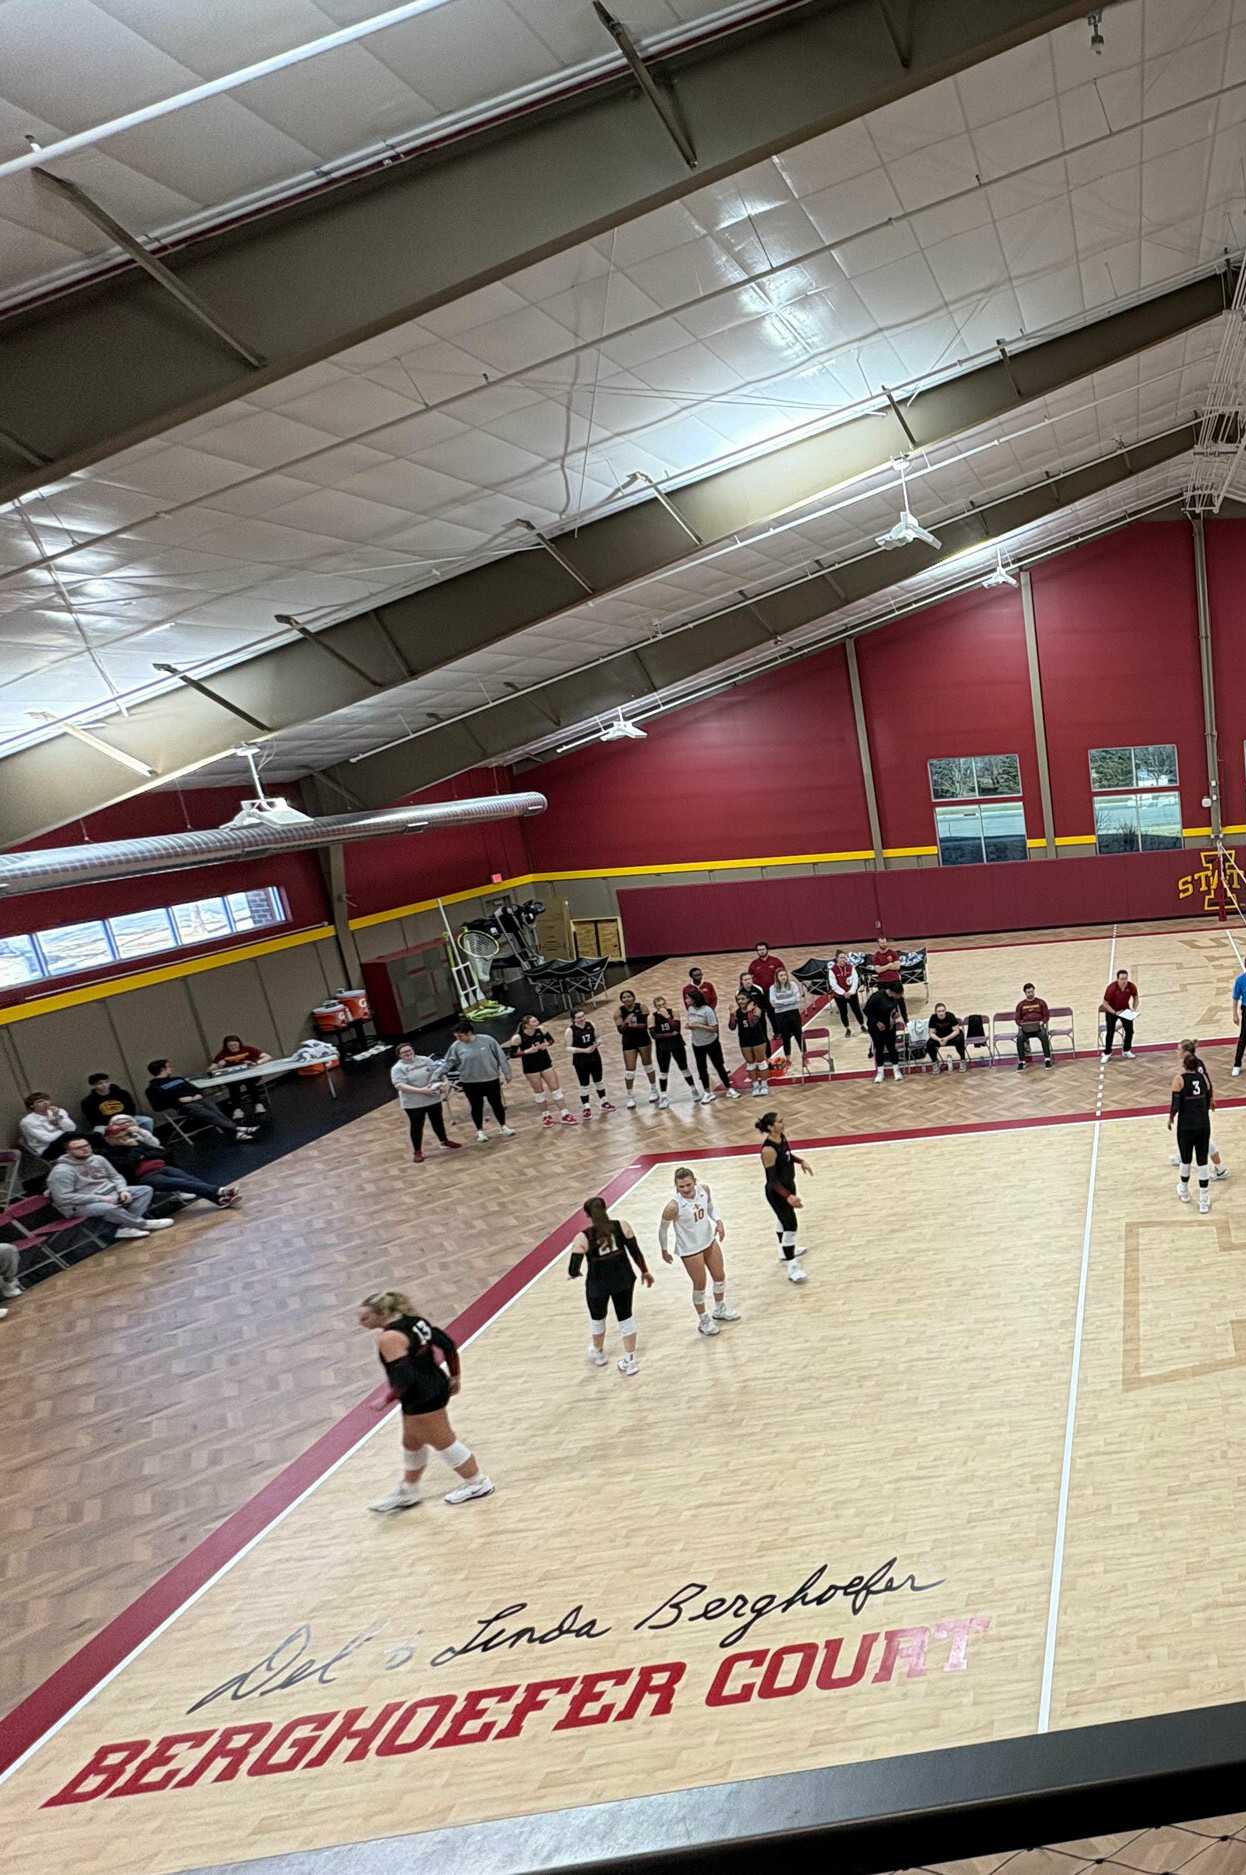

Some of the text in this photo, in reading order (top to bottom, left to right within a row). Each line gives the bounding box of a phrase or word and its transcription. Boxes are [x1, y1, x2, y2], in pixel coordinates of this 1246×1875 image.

[1192, 1080, 1201, 1095] 3
[693, 1208, 705, 1223] 10
[412, 1319, 432, 1345] 13
[430, 1602, 612, 1668] Linda
[633, 1556, 946, 1649] Berghoefer
[38, 1616, 990, 1810] BERGHOEFER COURT
